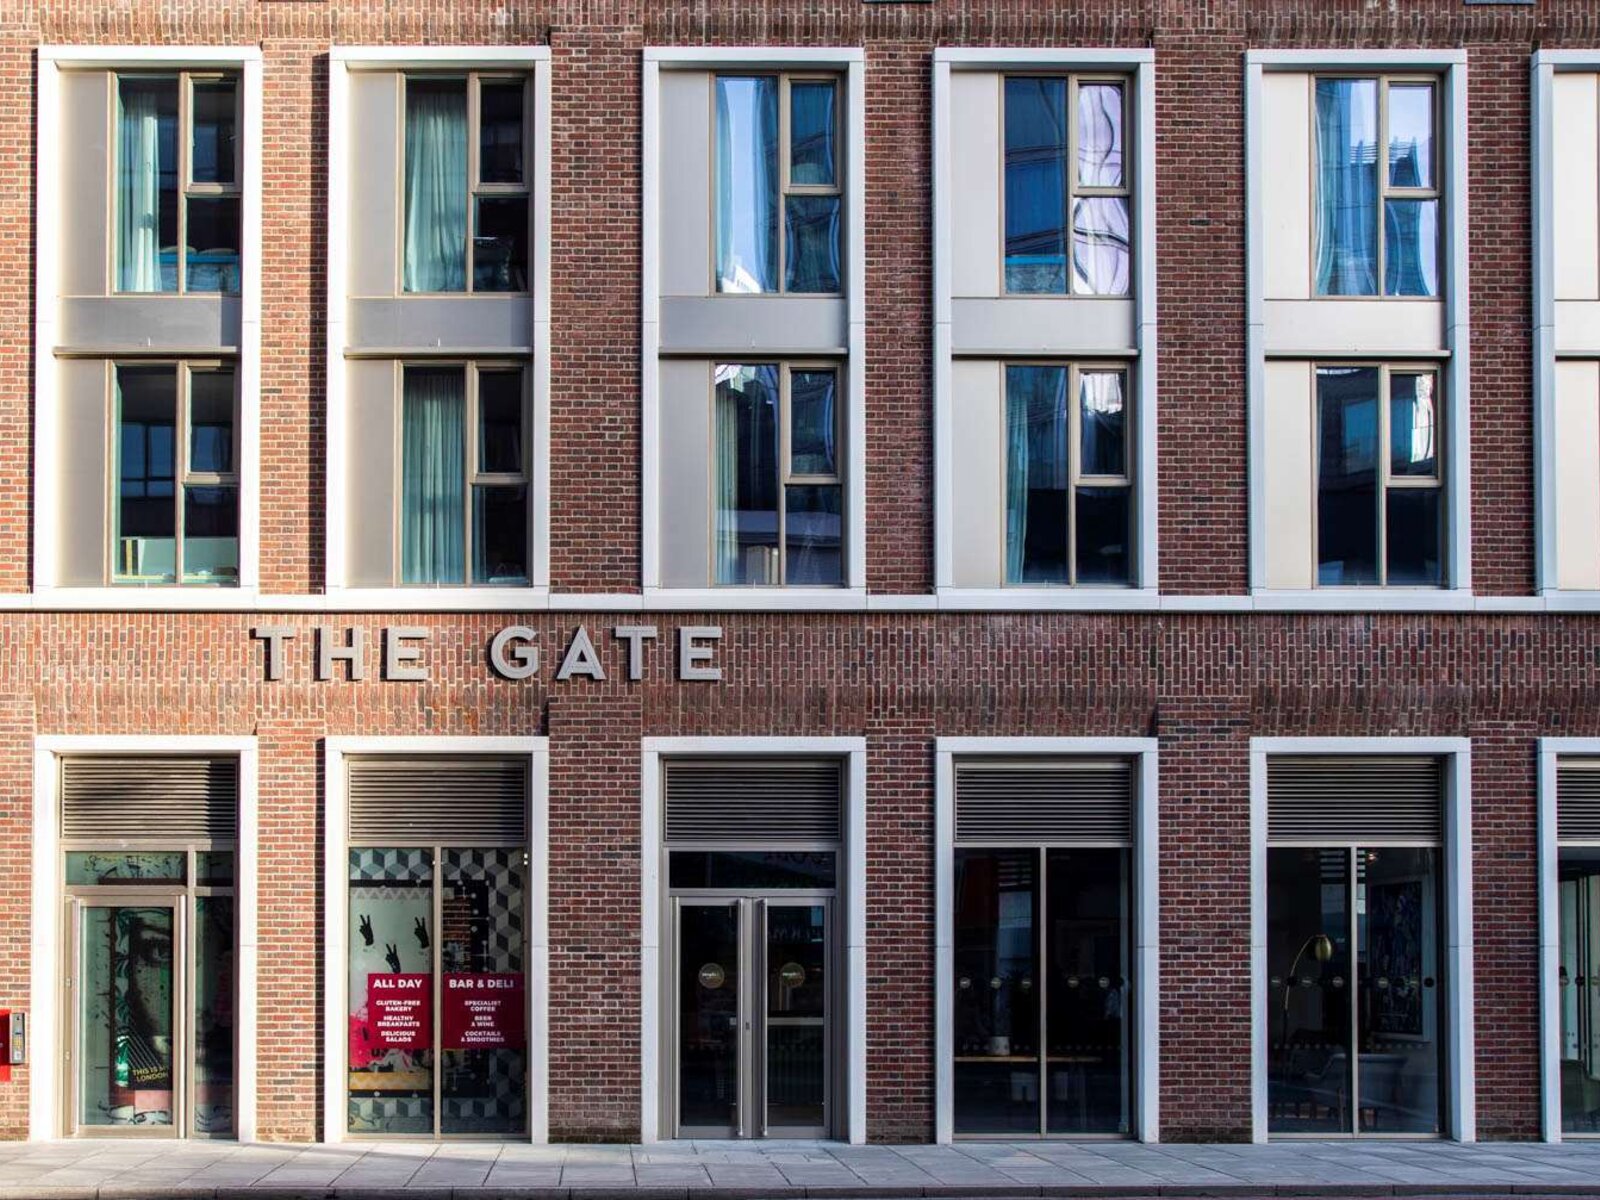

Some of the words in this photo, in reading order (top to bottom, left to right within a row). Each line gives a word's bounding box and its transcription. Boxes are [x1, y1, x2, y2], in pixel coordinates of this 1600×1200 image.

[251, 625, 429, 681] THE
[490, 624, 723, 681] GATE
[373, 979, 396, 989] ALL
[397, 979, 422, 989] DAY
[449, 979, 474, 989] BAR
[477, 979, 485, 989] &
[487, 979, 514, 989] DELI
[132, 1067, 150, 1076] THIS
[136, 1071, 169, 1083] LONDON
